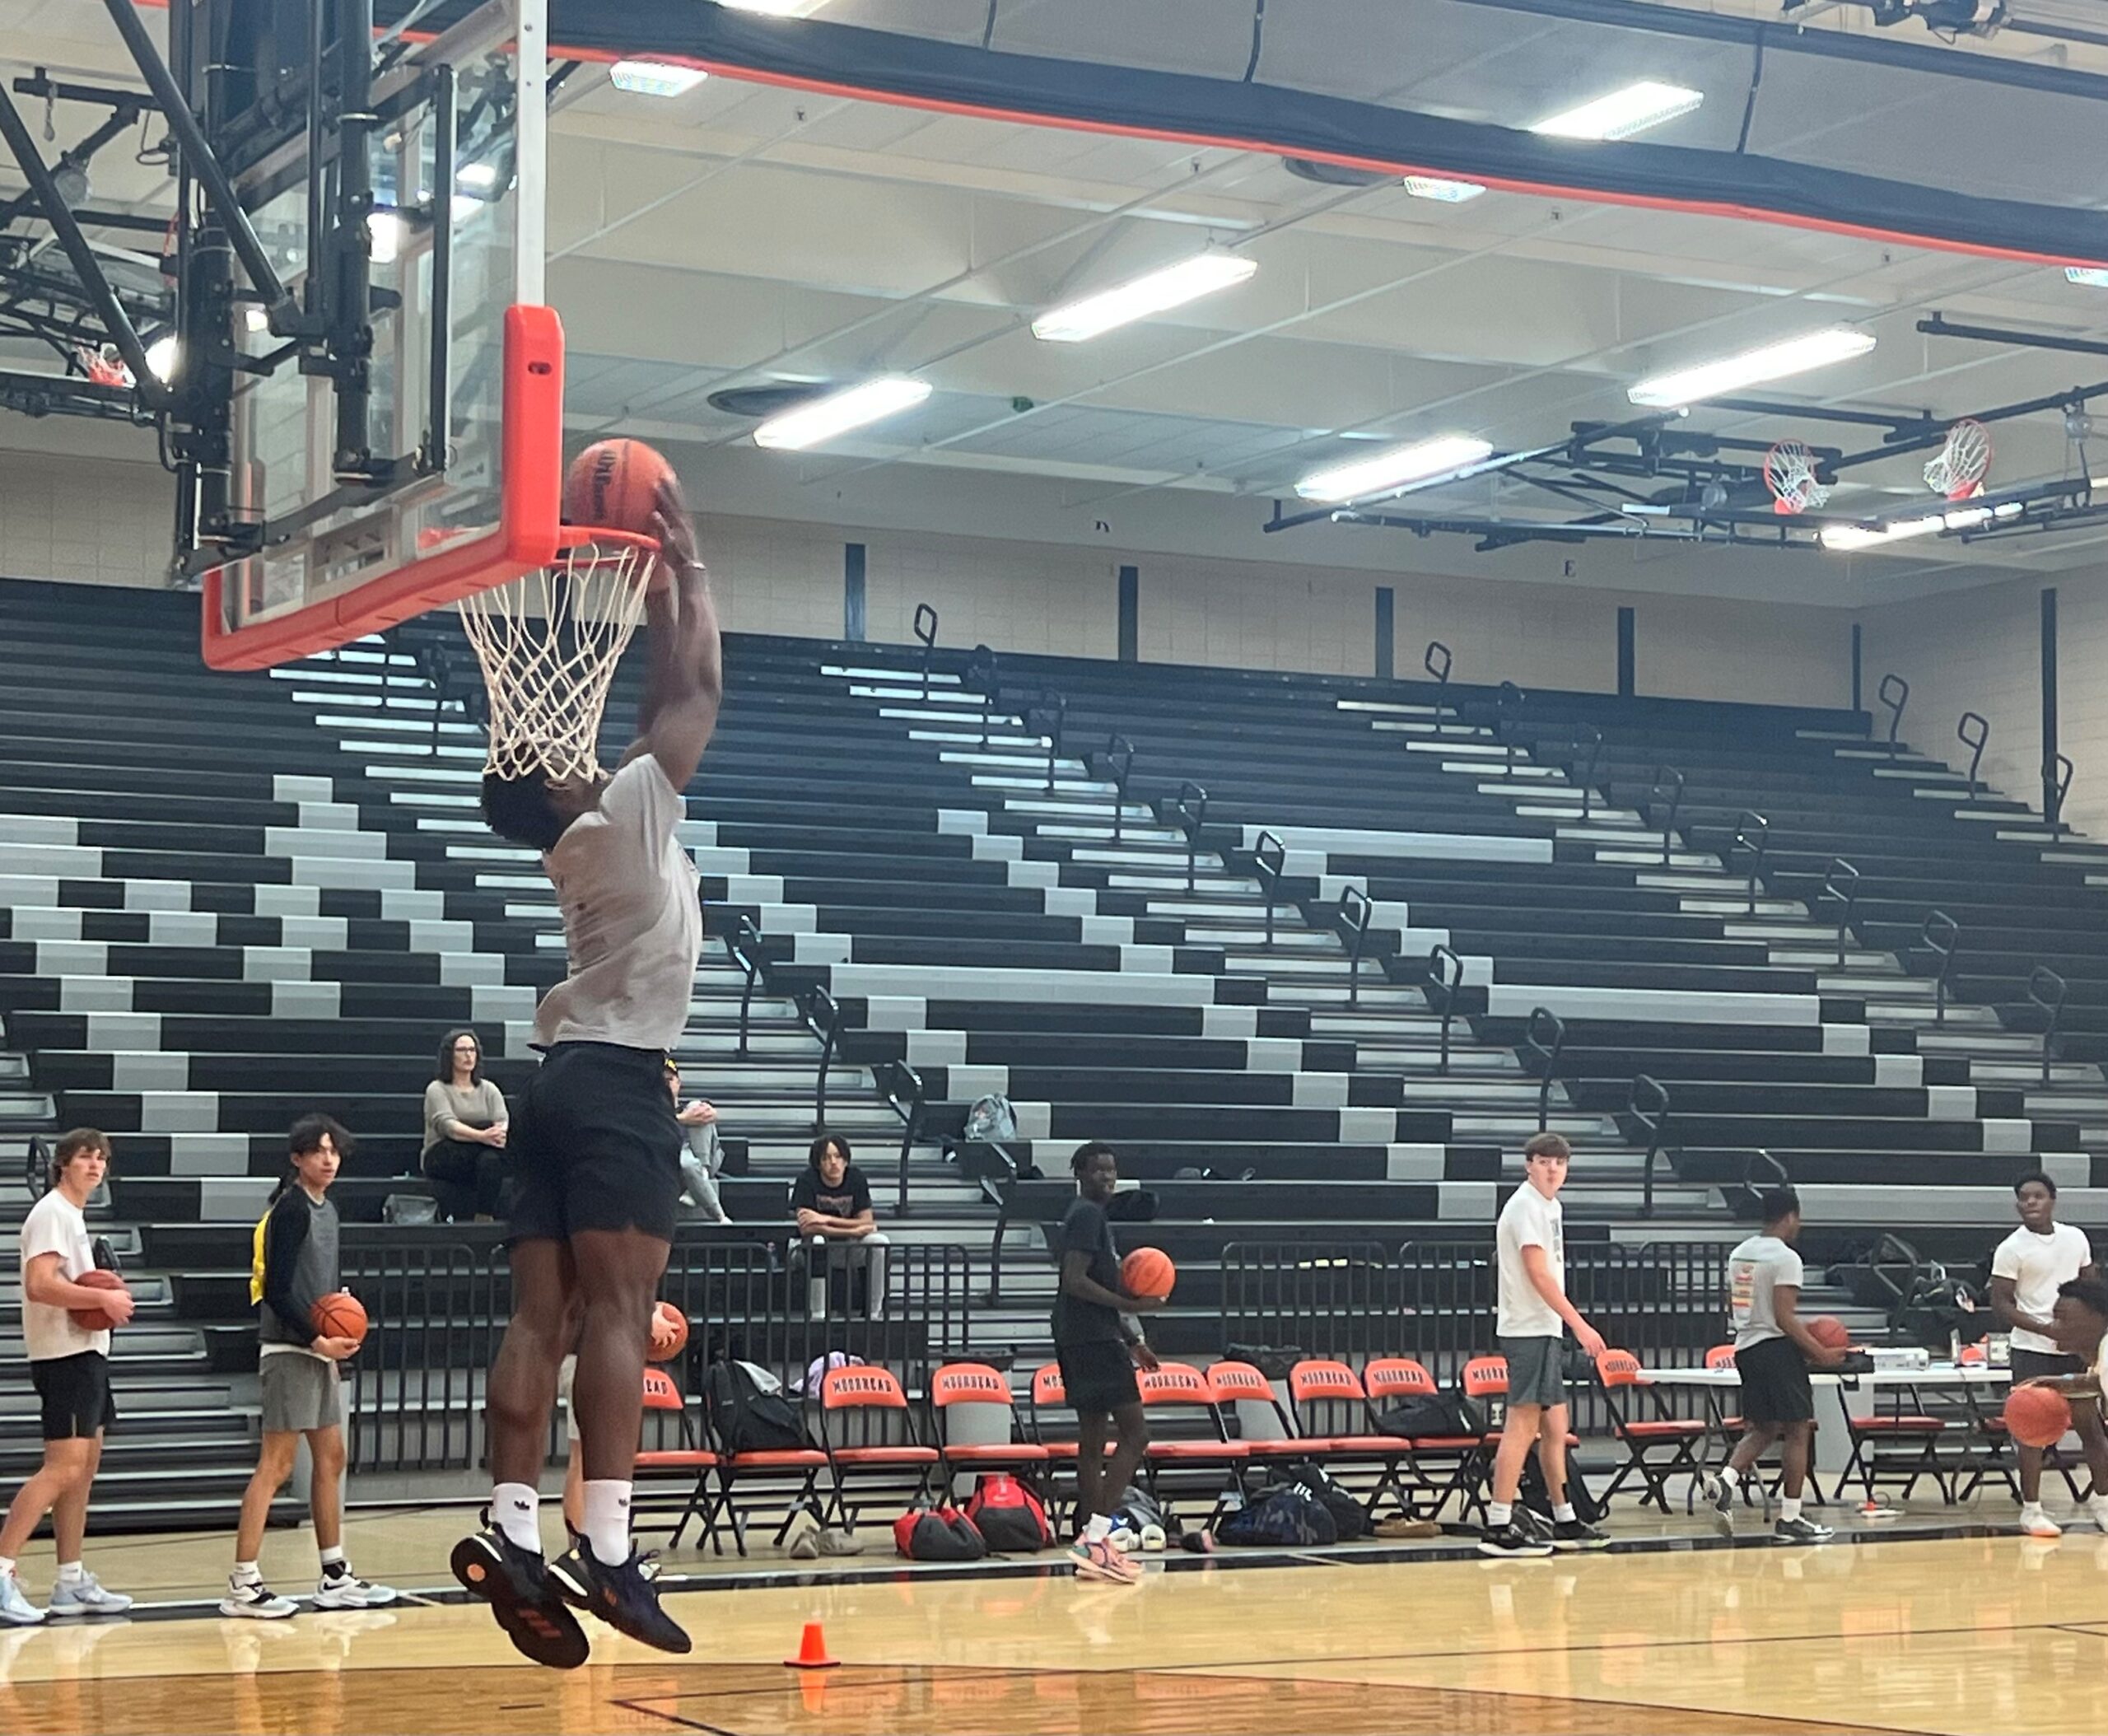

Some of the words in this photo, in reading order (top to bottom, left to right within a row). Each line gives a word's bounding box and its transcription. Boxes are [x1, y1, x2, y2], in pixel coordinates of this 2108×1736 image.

[942, 1374, 1000, 1390] MOORHEAD
[1144, 1374, 1199, 1389] MOORHEAD
[1216, 1373, 1262, 1388] MOORHEAD
[1300, 1370, 1351, 1385] MOORHEAD
[1373, 1370, 1424, 1384] MOORHEAD
[832, 1377, 892, 1393] MOORHEAD
